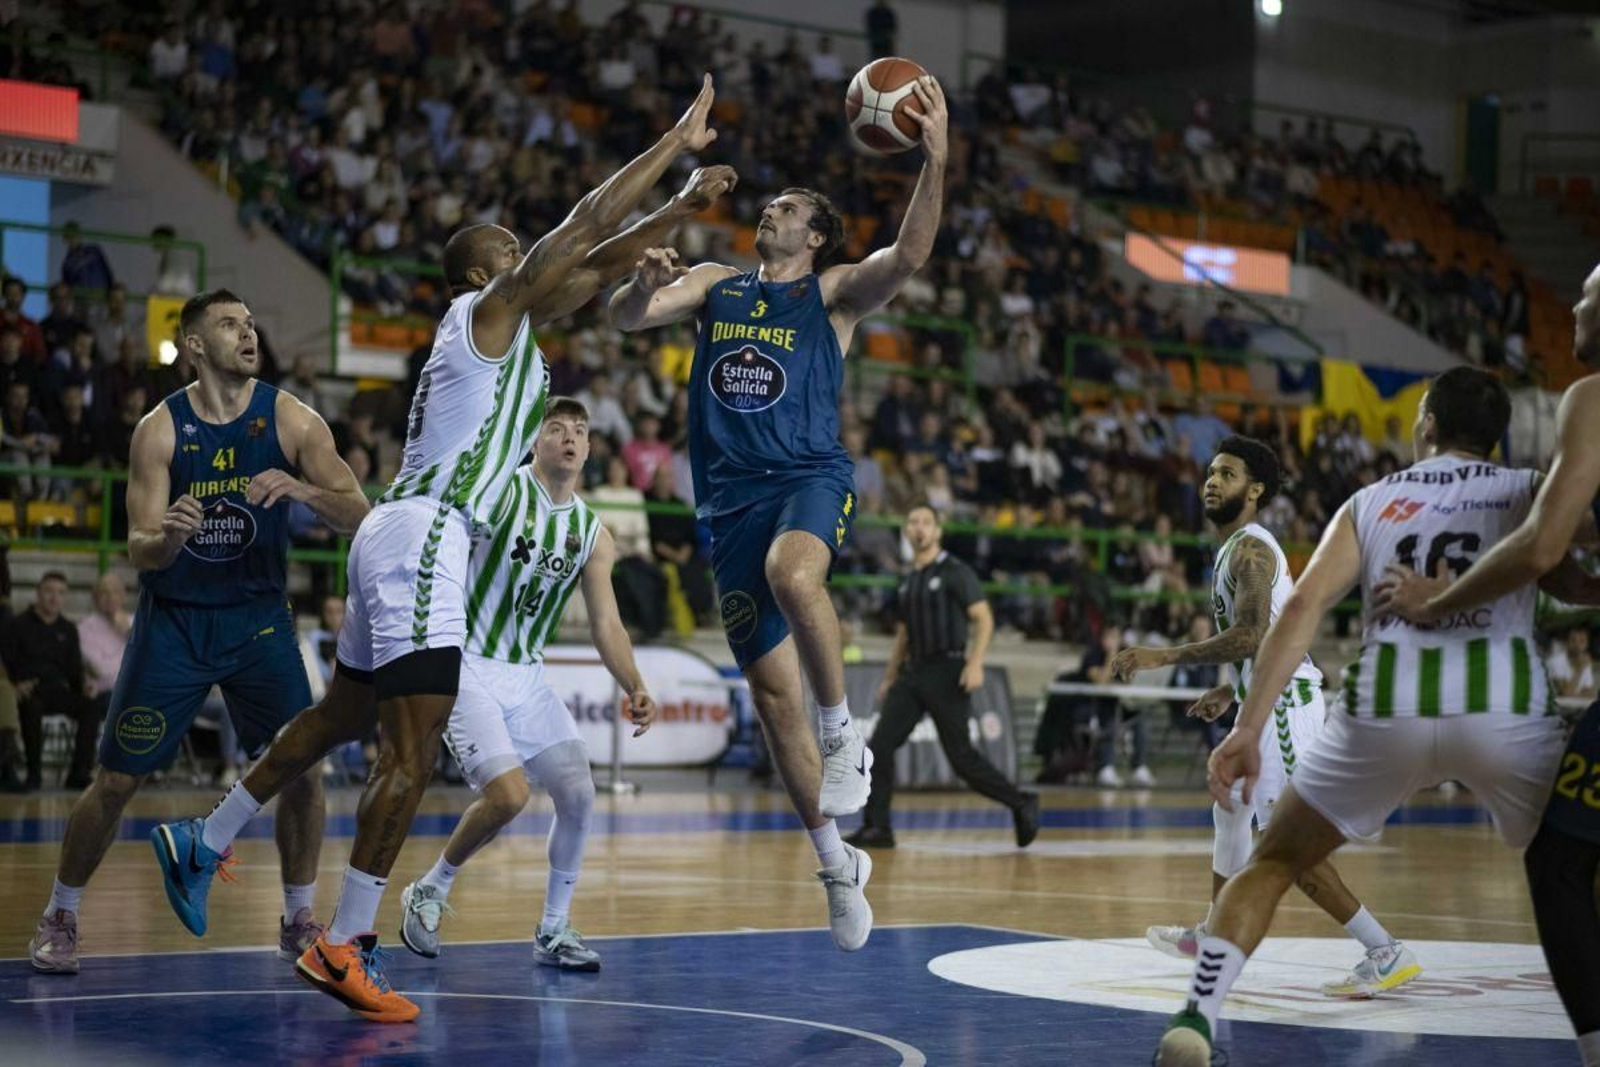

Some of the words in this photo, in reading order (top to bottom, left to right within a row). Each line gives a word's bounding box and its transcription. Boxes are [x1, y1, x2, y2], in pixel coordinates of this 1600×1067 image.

[0, 148, 96, 175] XENCIA
[751, 300, 768, 318] 3
[712, 321, 796, 352] OURENSE
[722, 362, 773, 382] Estrella
[722, 379, 768, 396] Galicia
[212, 447, 235, 470] 41
[201, 516, 245, 530] strella
[195, 530, 242, 545] Galicia
[515, 583, 545, 617] 14
